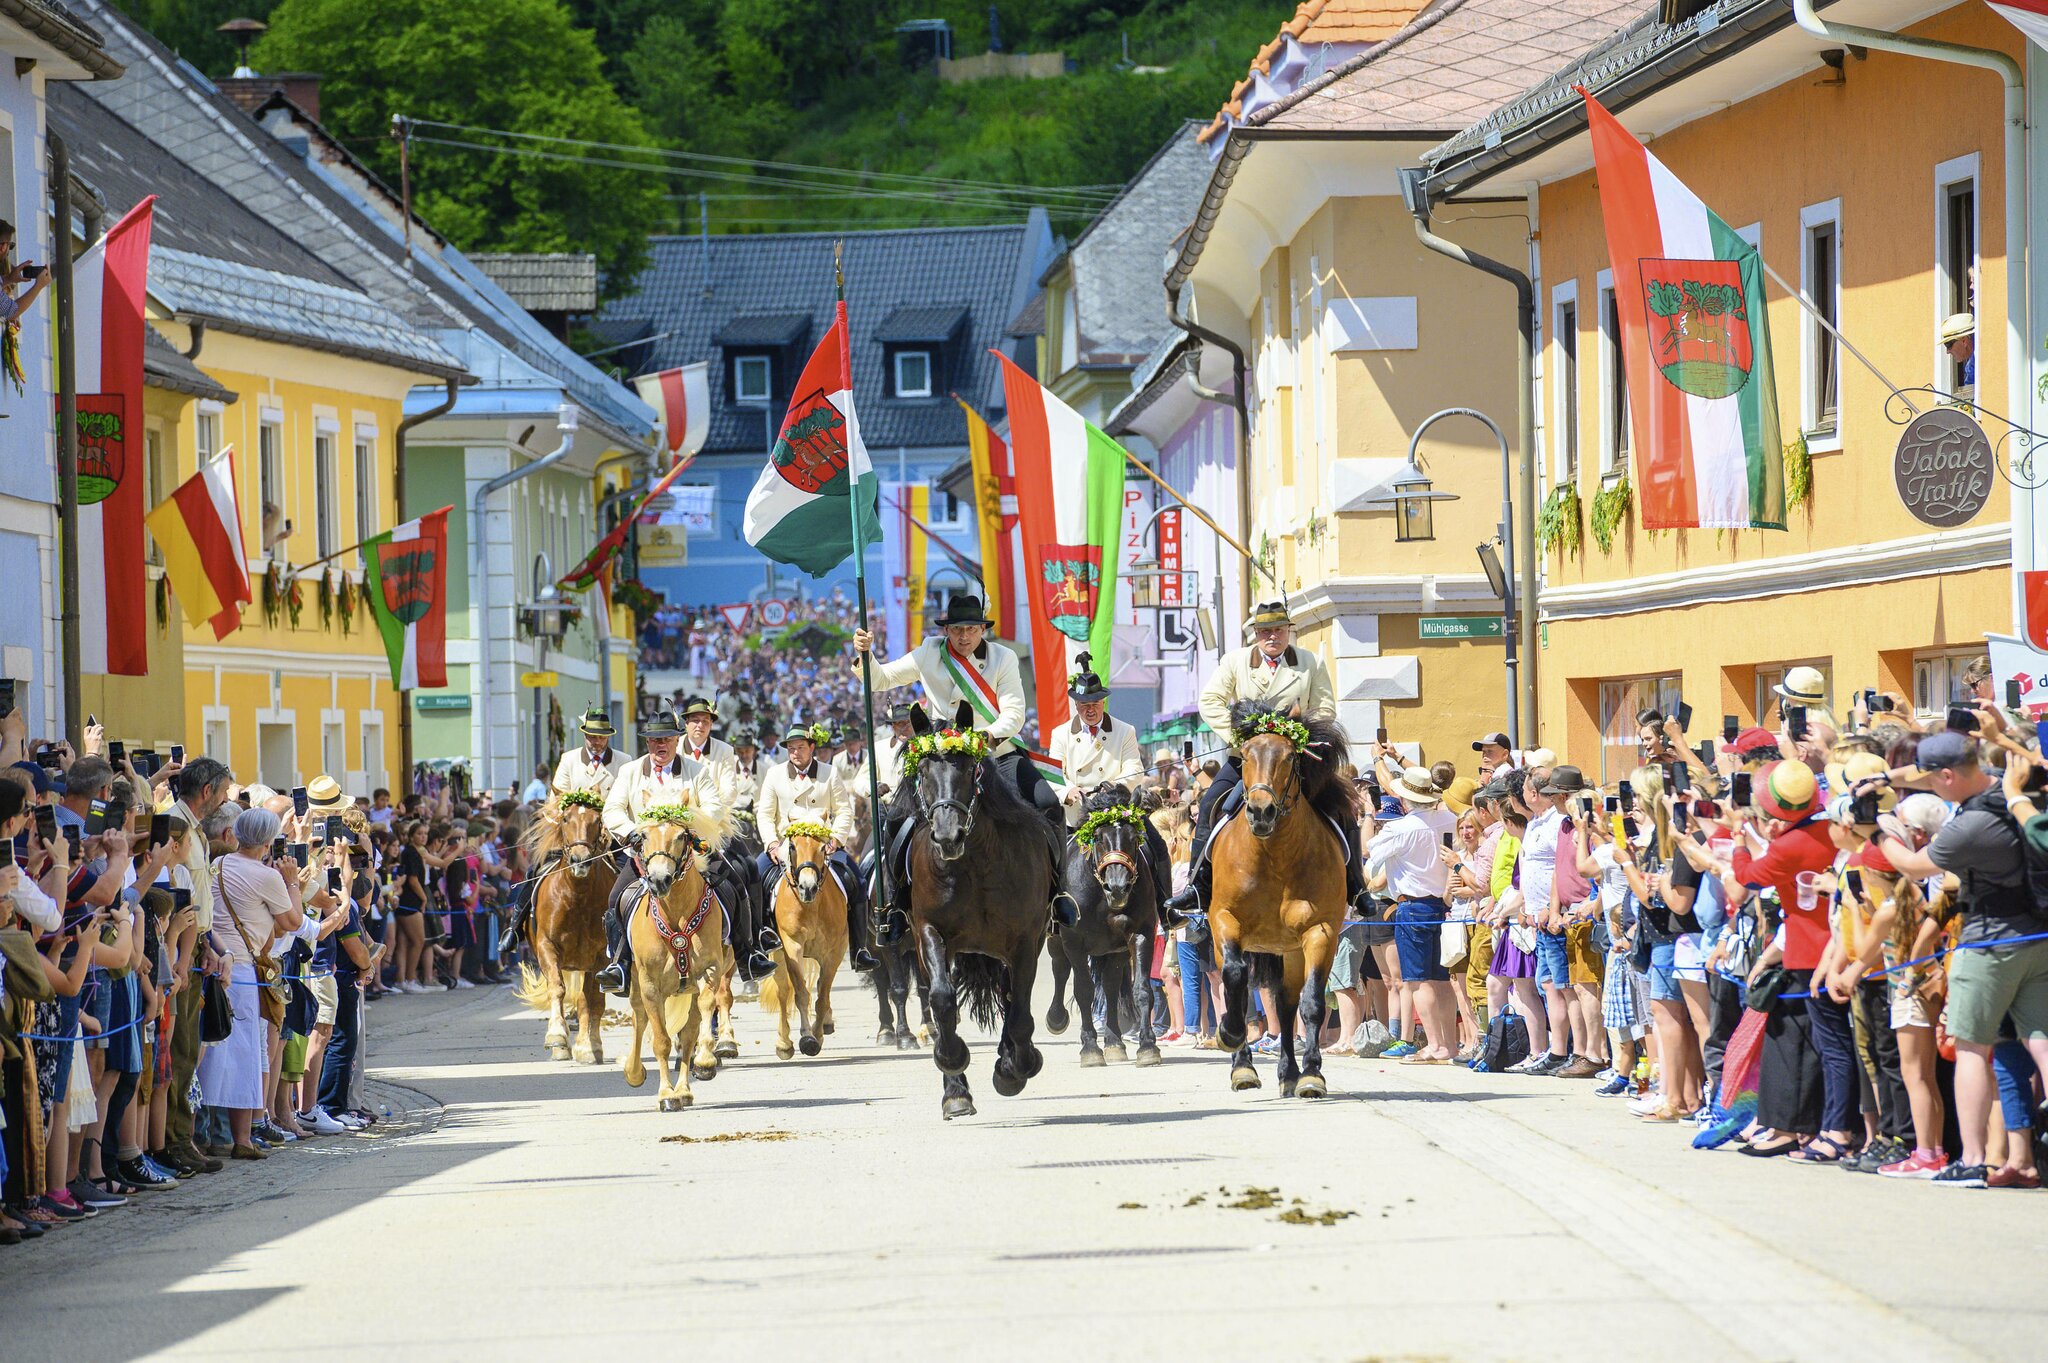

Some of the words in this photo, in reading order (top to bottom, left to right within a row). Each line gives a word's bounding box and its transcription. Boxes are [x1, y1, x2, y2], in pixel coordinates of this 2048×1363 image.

[1901, 439, 1986, 475] Tabak
[1906, 469, 1987, 506] Trafik
[1163, 511, 1177, 600] ZIMMER
[1423, 622, 1469, 635] Mühlgasse
